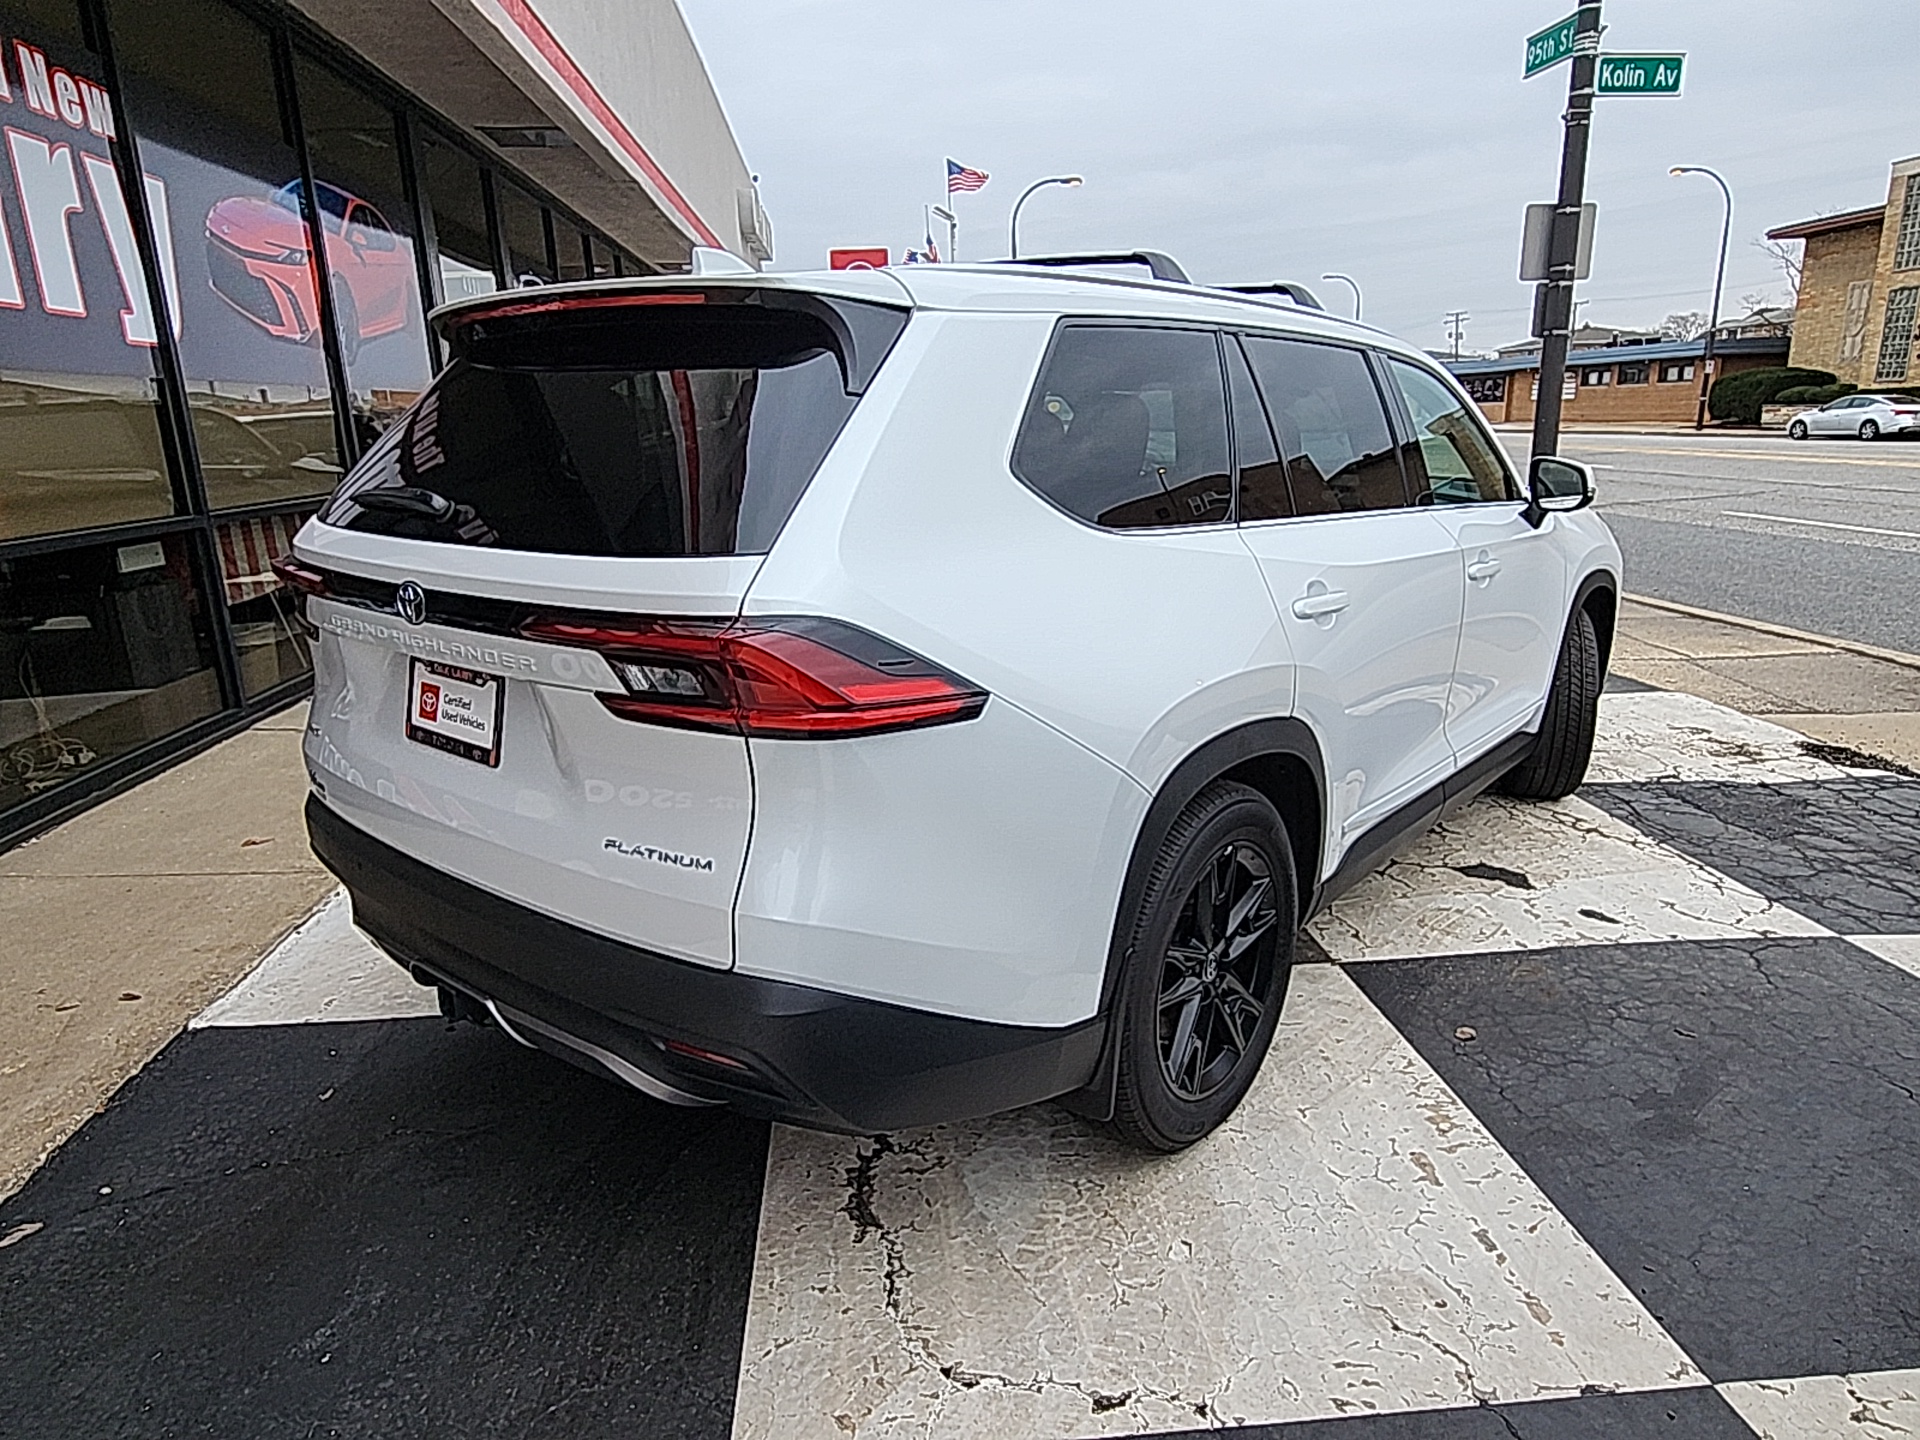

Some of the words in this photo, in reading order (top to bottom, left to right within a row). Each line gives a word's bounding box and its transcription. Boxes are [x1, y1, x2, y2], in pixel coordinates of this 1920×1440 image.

[1527, 33, 1555, 68] 95th
[1559, 26, 1575, 54] St
[13, 38, 117, 142] New
[1601, 63, 1646, 88] Kolin
[1652, 63, 1679, 88] Av
[330, 614, 388, 639] GRAND
[391, 629, 538, 672] HIGHLANDER
[443, 693, 472, 711] Certified
[441, 708, 458, 723] Used
[459, 712, 486, 732] Vehicles
[603, 837, 714, 872] PLATINUM
